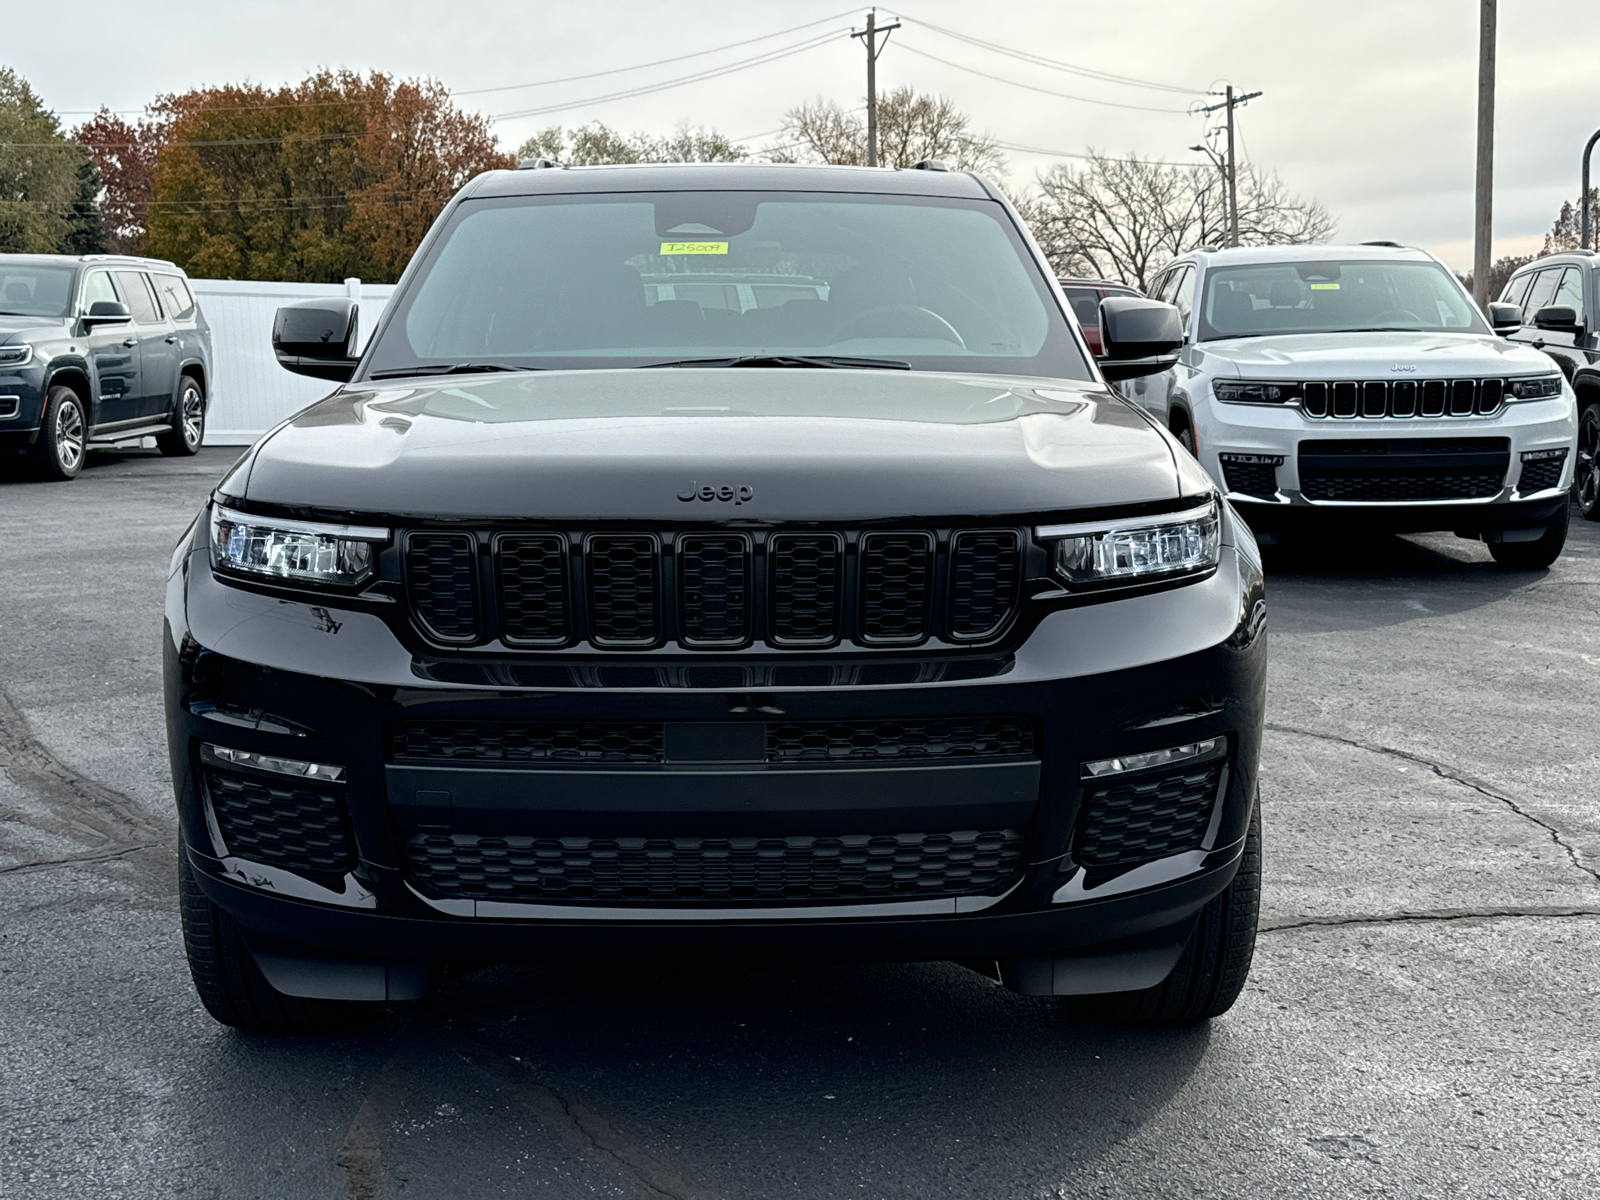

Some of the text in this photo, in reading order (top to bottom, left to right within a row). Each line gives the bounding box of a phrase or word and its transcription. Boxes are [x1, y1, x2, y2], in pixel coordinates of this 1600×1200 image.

[667, 243, 720, 252] J25009
[1391, 363, 1417, 373] Jeep
[676, 480, 754, 506] Jeep
